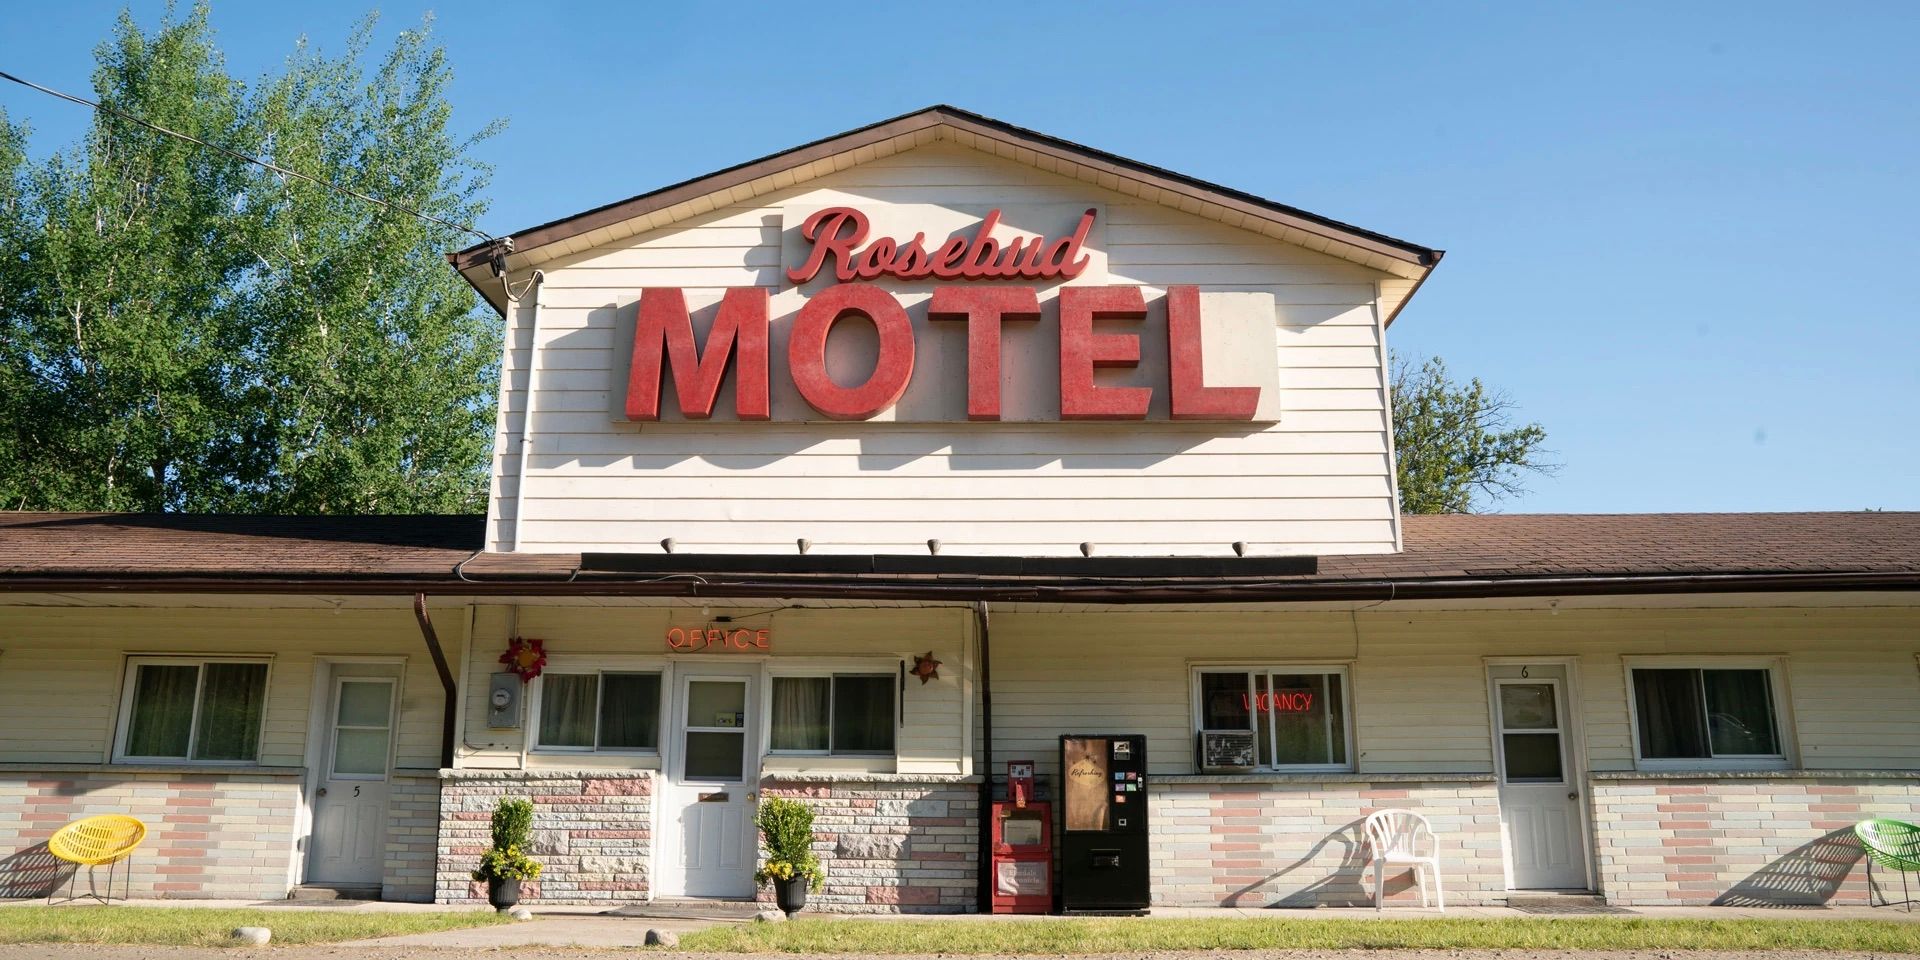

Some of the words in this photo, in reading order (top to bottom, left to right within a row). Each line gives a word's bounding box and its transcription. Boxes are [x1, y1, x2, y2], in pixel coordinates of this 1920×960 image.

[786, 206, 1098, 285] Rosebud
[625, 284, 1262, 421] MOTEL
[668, 628, 769, 649] OFFICE
[1521, 664, 1529, 679] 6
[1242, 692, 1313, 712] VACANCY
[1070, 768, 1103, 778] Refreshing
[353, 785, 361, 798] 5
